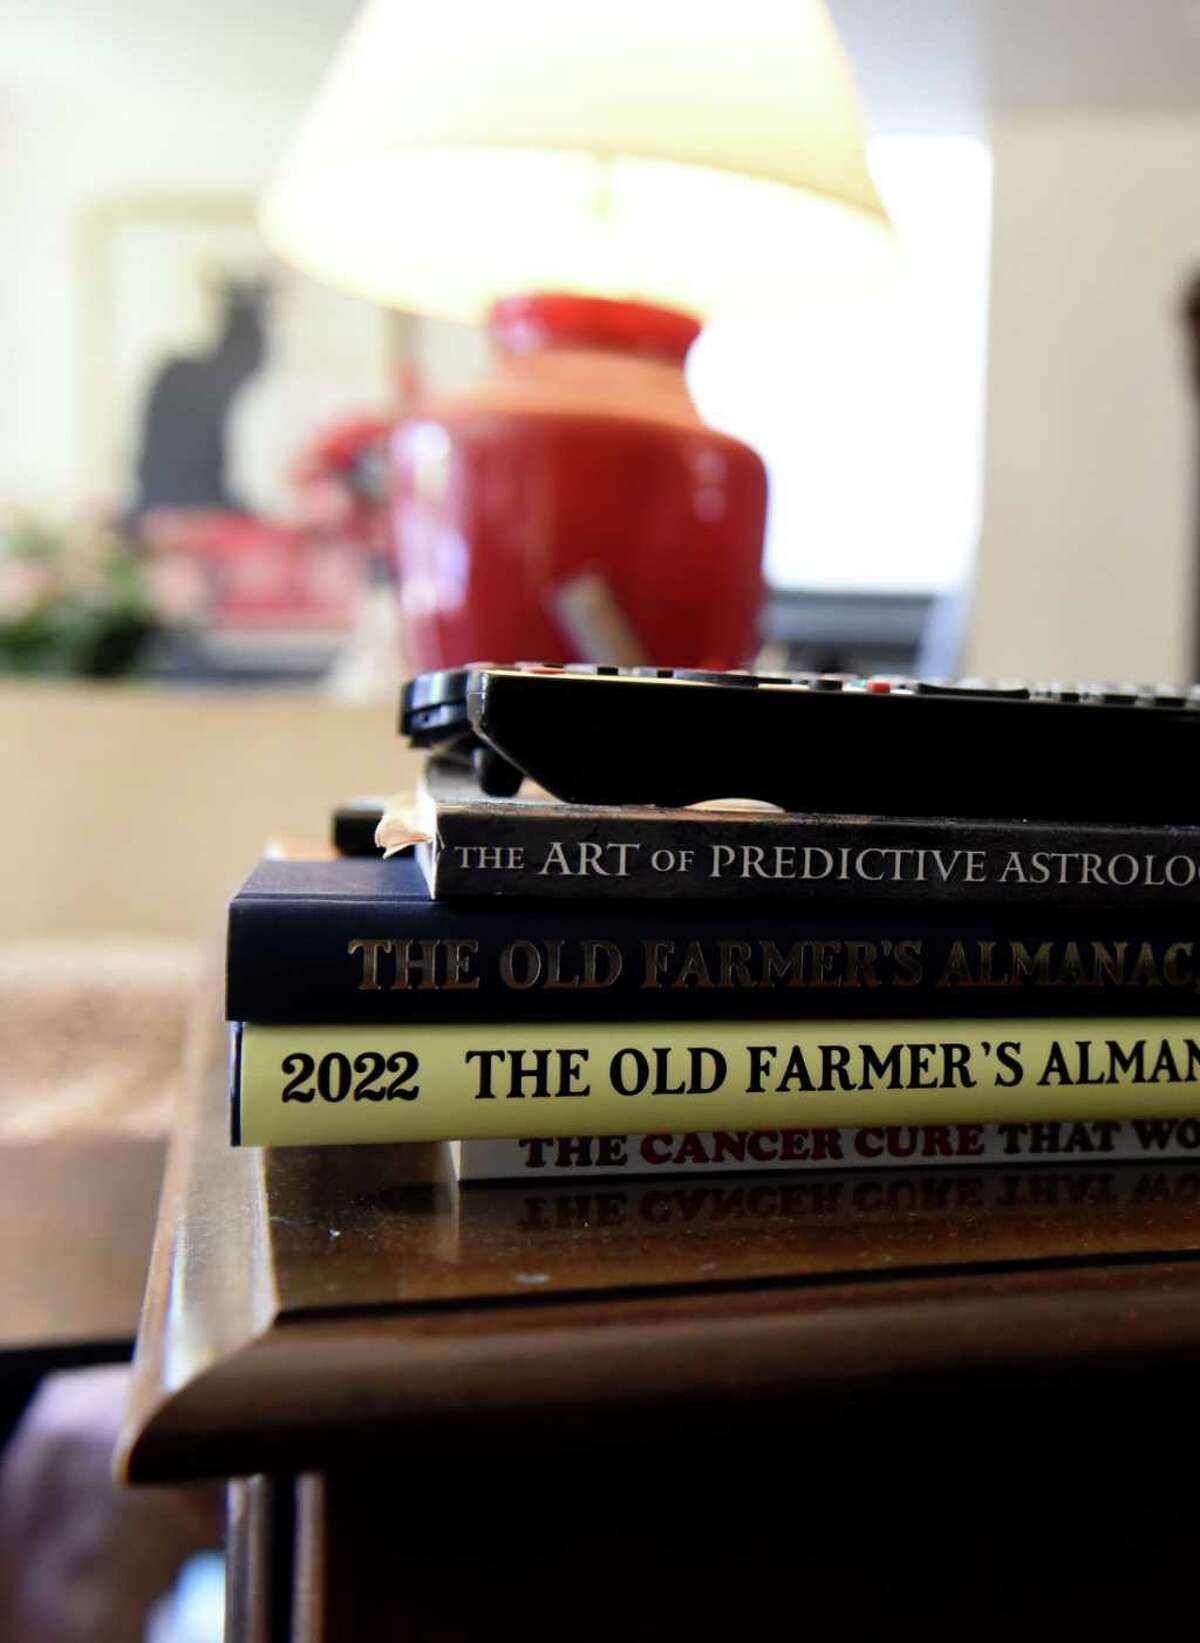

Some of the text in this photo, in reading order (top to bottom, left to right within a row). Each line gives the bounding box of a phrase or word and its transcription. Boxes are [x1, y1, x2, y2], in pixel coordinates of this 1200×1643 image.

[455, 845, 524, 871] THE
[538, 841, 640, 877] ART
[651, 849, 694, 873] OF
[710, 843, 987, 883] PREDICTIVE
[348, 939, 479, 989] THE
[500, 939, 623, 989] OLD
[641, 939, 924, 989] FARMER'S
[281, 1052, 419, 1101] 2022
[465, 1049, 590, 1099] THE
[609, 1046, 728, 1095] OLD
[746, 1041, 1024, 1092] FARMER'S
[519, 1137, 627, 1167] THE
[641, 1129, 843, 1164] CANCER
[854, 1123, 984, 1159] CURE
[998, 1122, 1119, 1152] THAT
